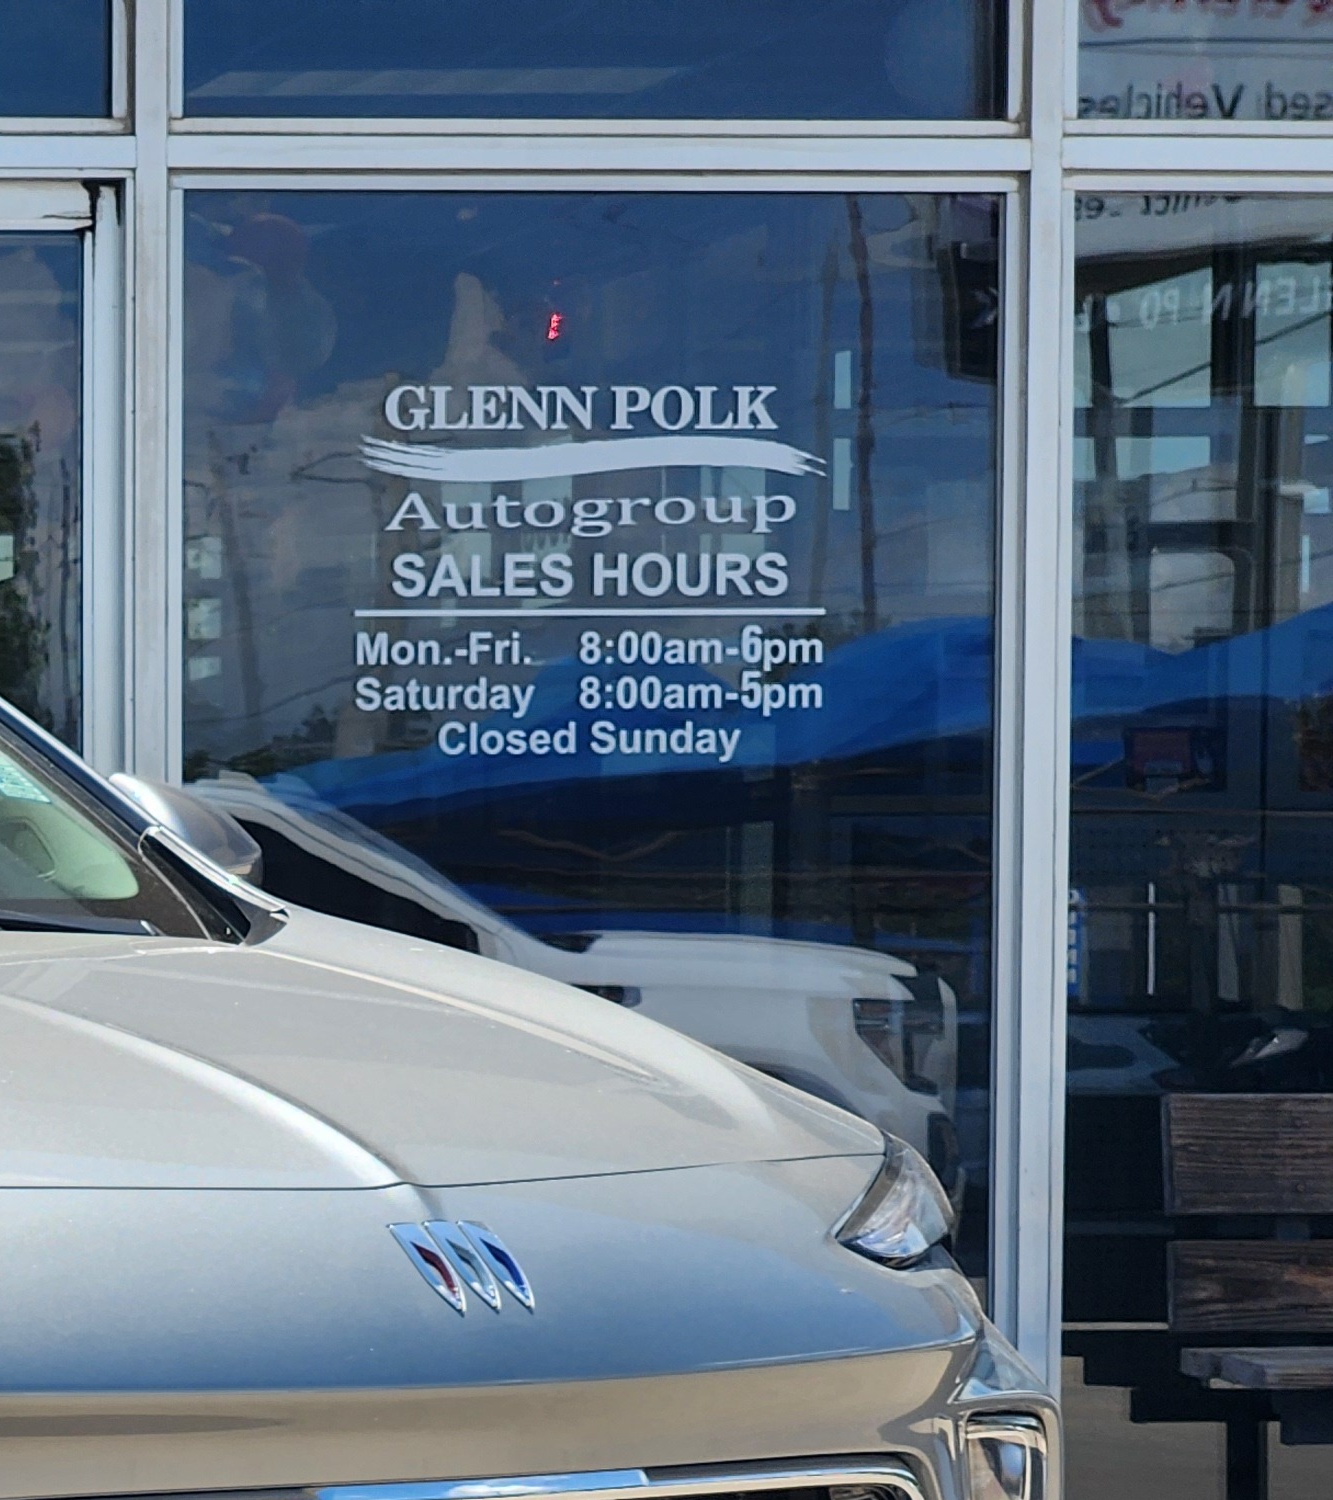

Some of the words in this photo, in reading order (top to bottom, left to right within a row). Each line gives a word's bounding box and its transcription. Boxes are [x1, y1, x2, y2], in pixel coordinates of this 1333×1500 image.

[385, 385, 597, 431] GLENN
[610, 385, 778, 430] POLK
[385, 493, 797, 537] Autogroup
[391, 553, 574, 598] SALES
[593, 552, 789, 597] HOURS
[355, 631, 532, 666] Mon.-Fri.
[579, 625, 824, 672] 8:00am-6pm
[354, 677, 535, 718] Saturday
[579, 668, 823, 717] 8:00am-5pm
[438, 721, 576, 755] Closed
[590, 721, 741, 762] Sunday
